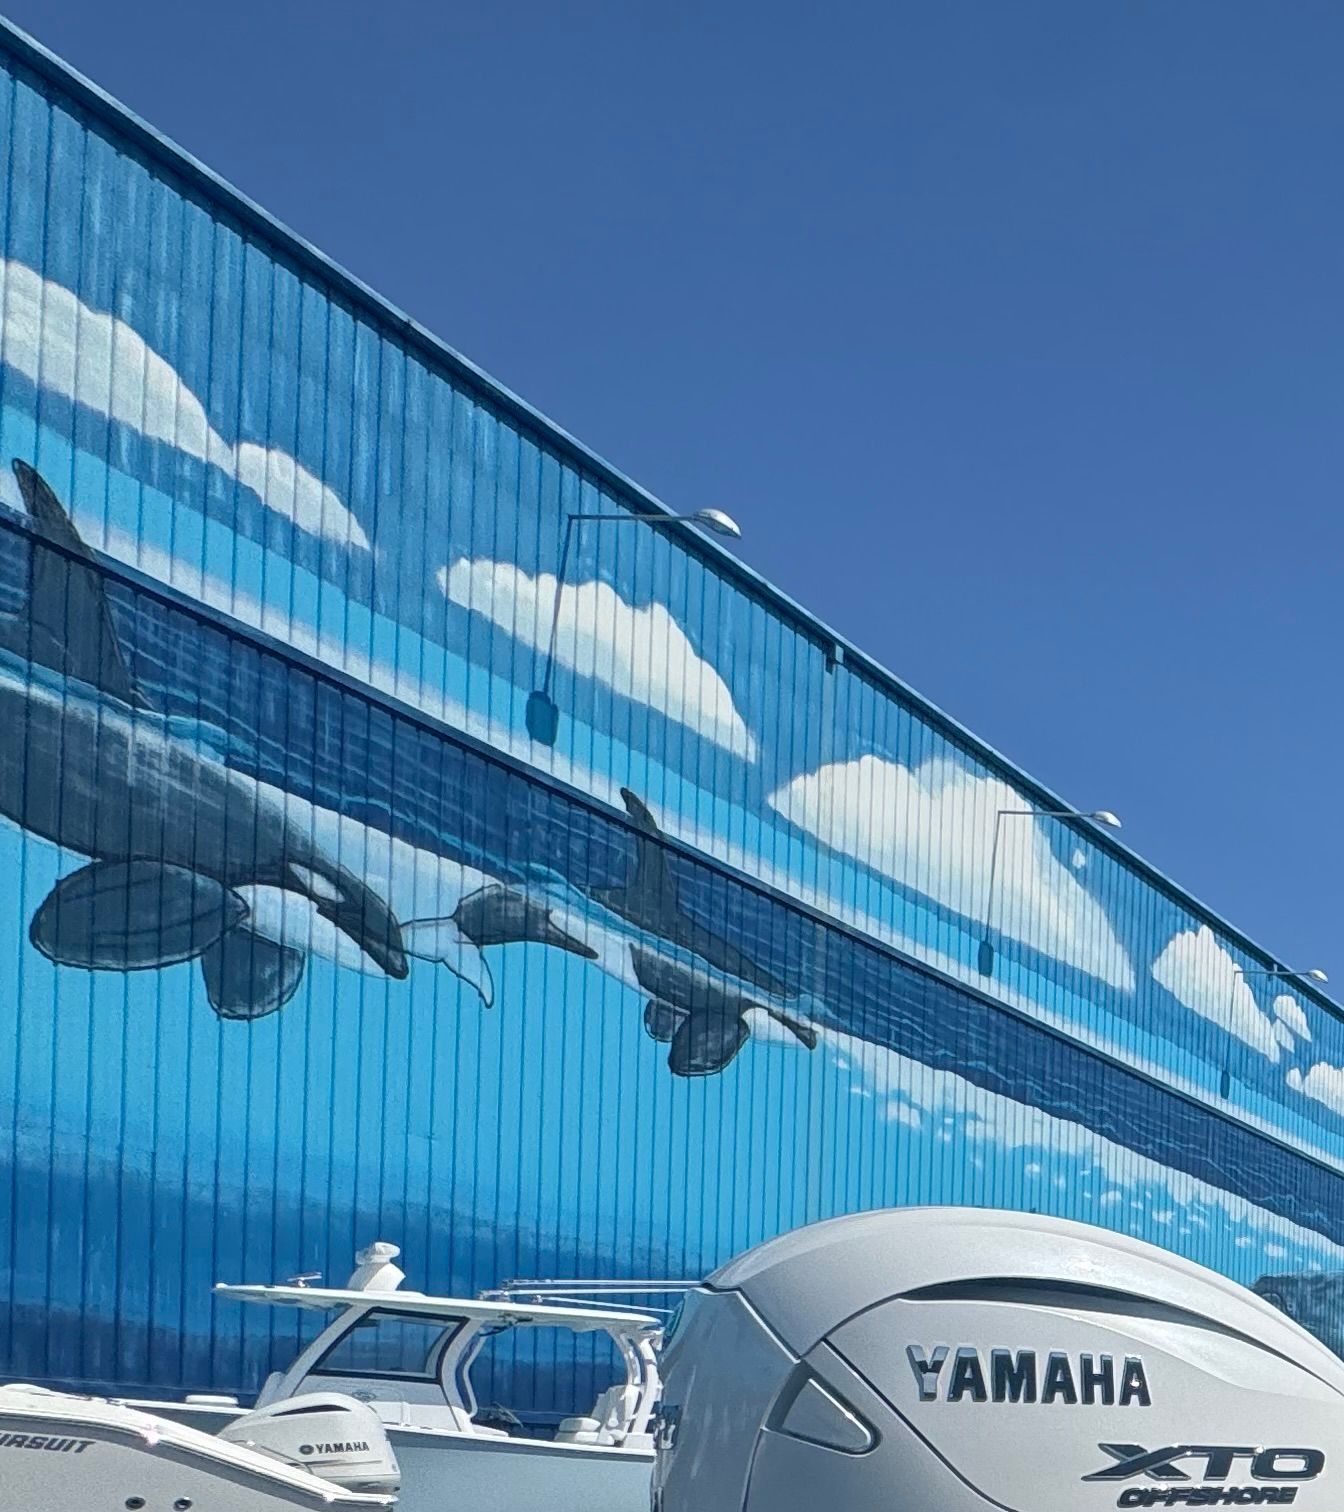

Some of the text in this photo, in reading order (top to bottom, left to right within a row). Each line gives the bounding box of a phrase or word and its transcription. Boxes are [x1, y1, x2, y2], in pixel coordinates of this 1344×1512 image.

[905, 1344, 1151, 1406] YAMAHA
[315, 1441, 369, 1454] YAMAHA
[1080, 1442, 1326, 1481] XTO
[1116, 1485, 1299, 1509] OFFSHORE
